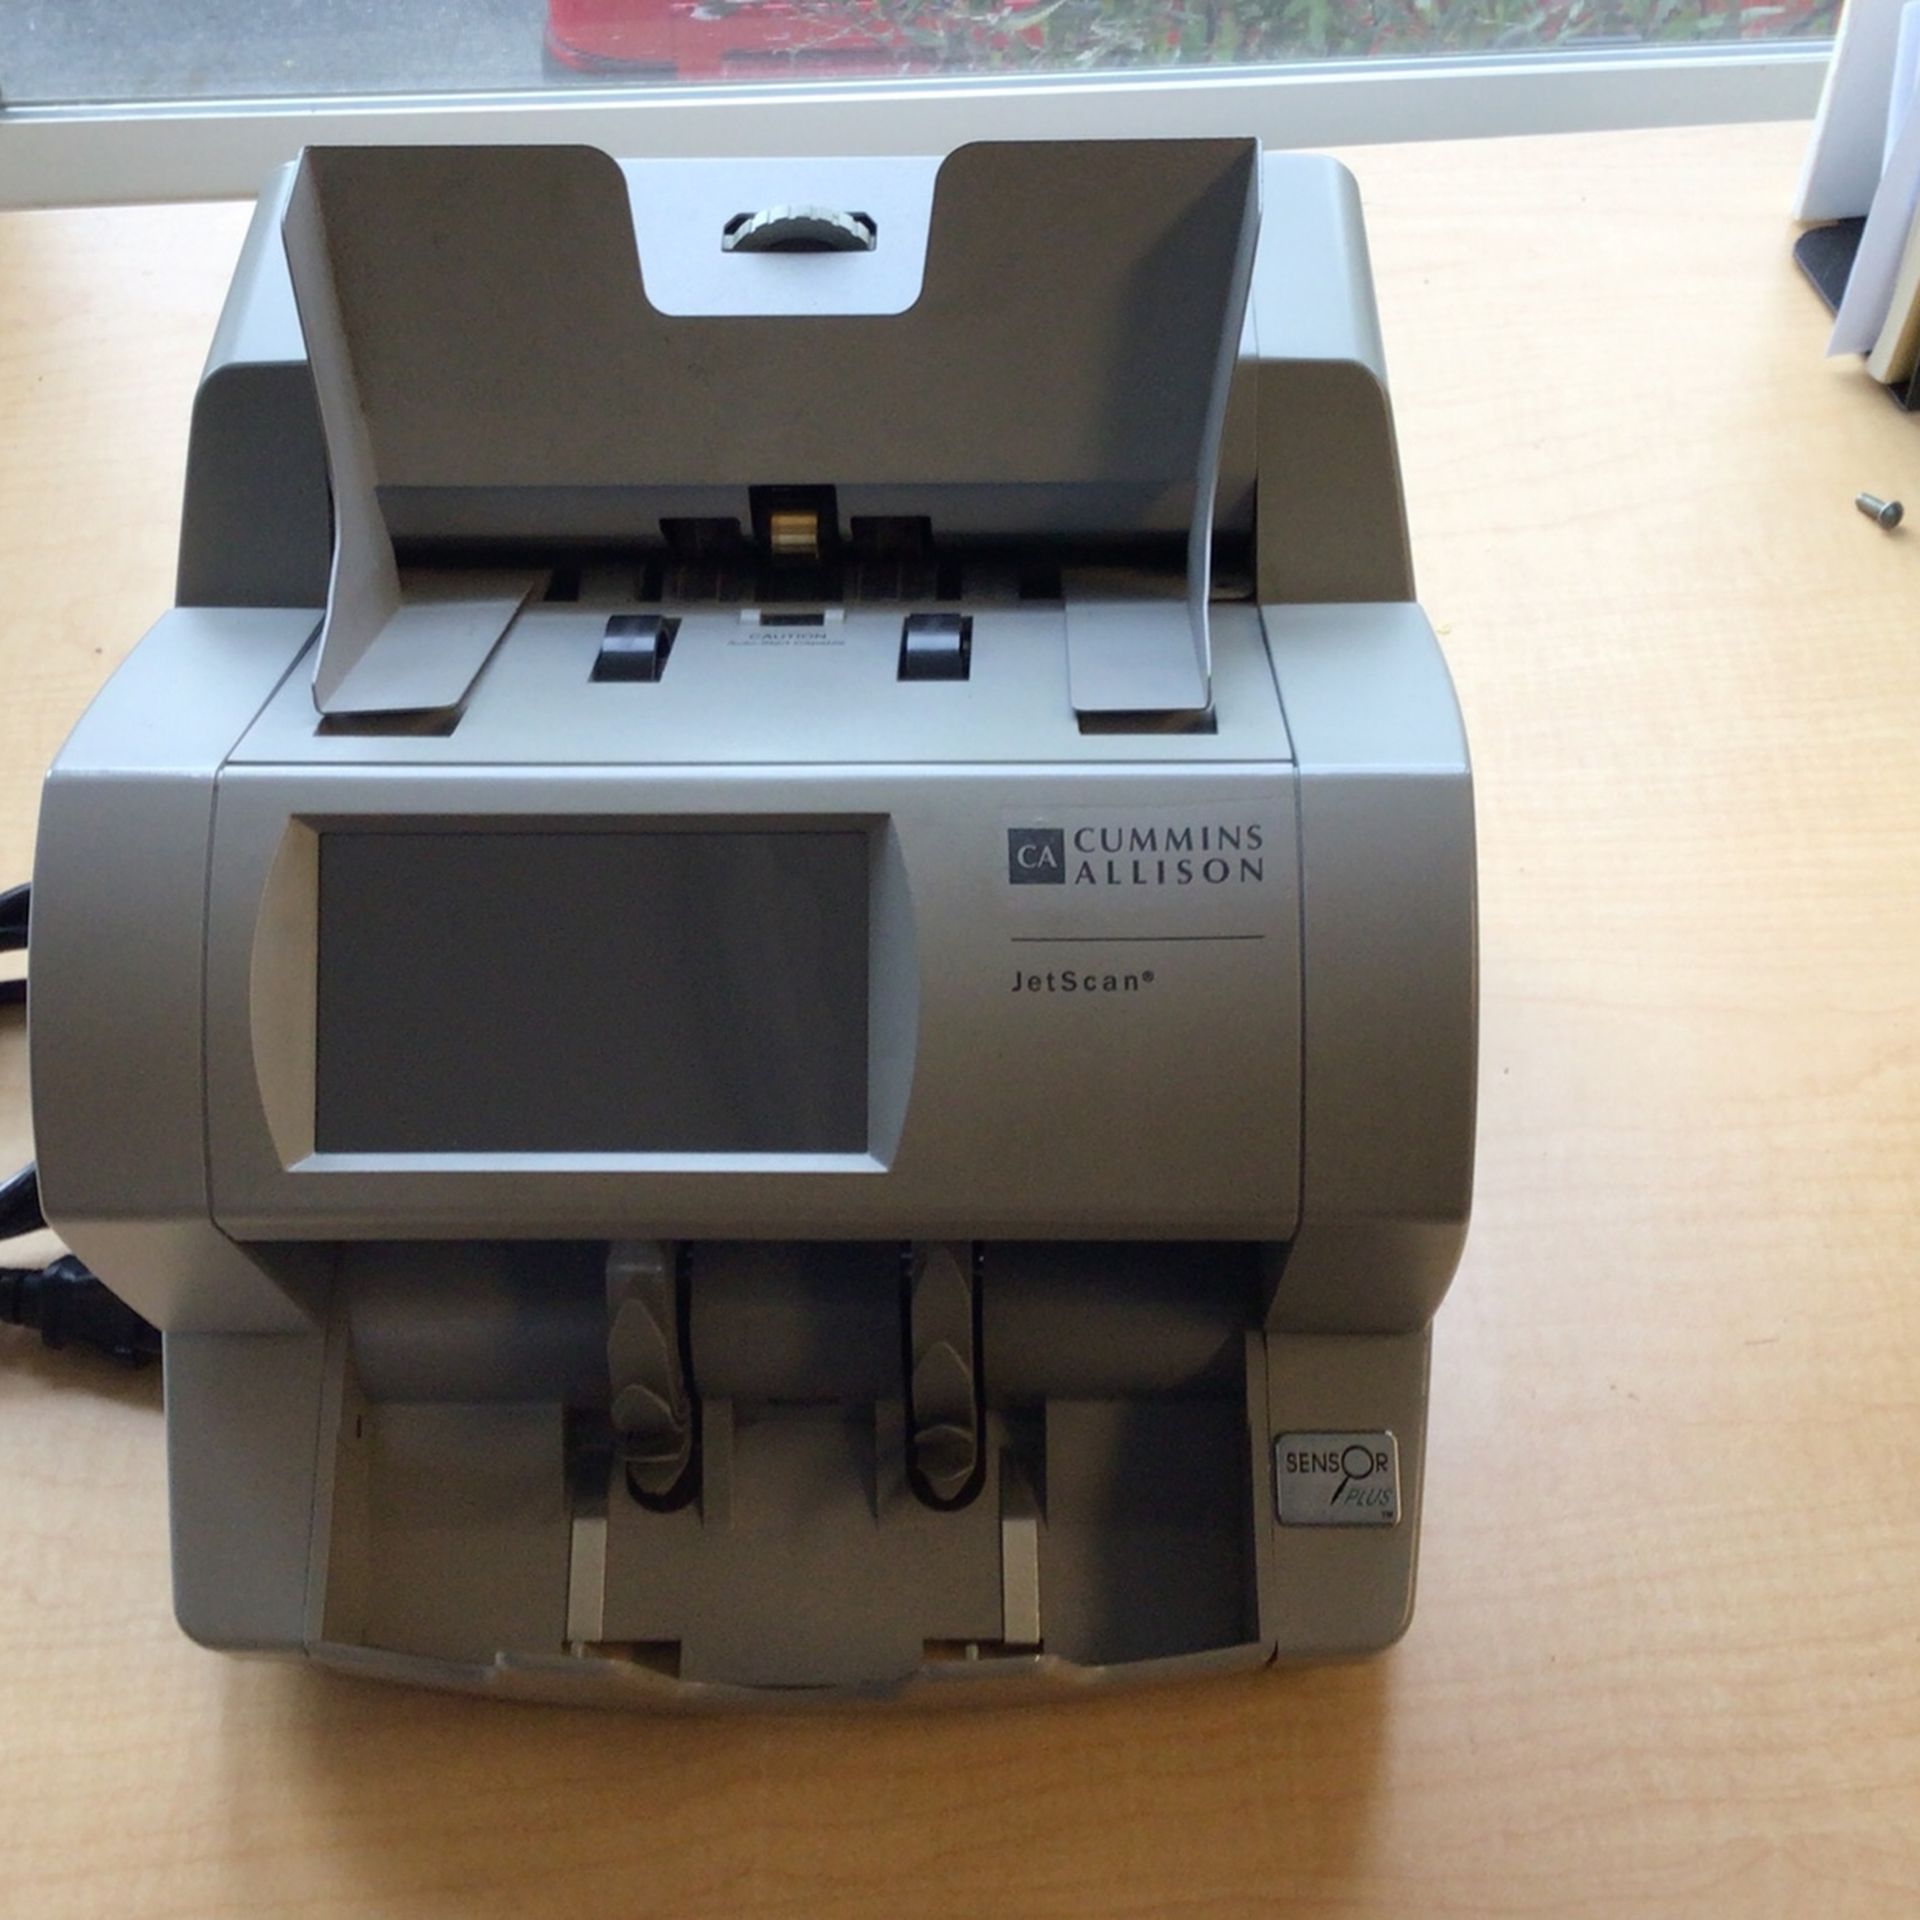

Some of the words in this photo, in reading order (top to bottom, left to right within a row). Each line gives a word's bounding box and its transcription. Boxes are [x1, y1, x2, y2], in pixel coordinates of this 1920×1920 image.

[1074, 824, 1263, 853] CUMMINS
[1017, 844, 1058, 869] CA
[1074, 857, 1264, 885] ALLISON
[1286, 1445, 1389, 1480] SENSOR
[1343, 1488, 1392, 1507] PLUS
